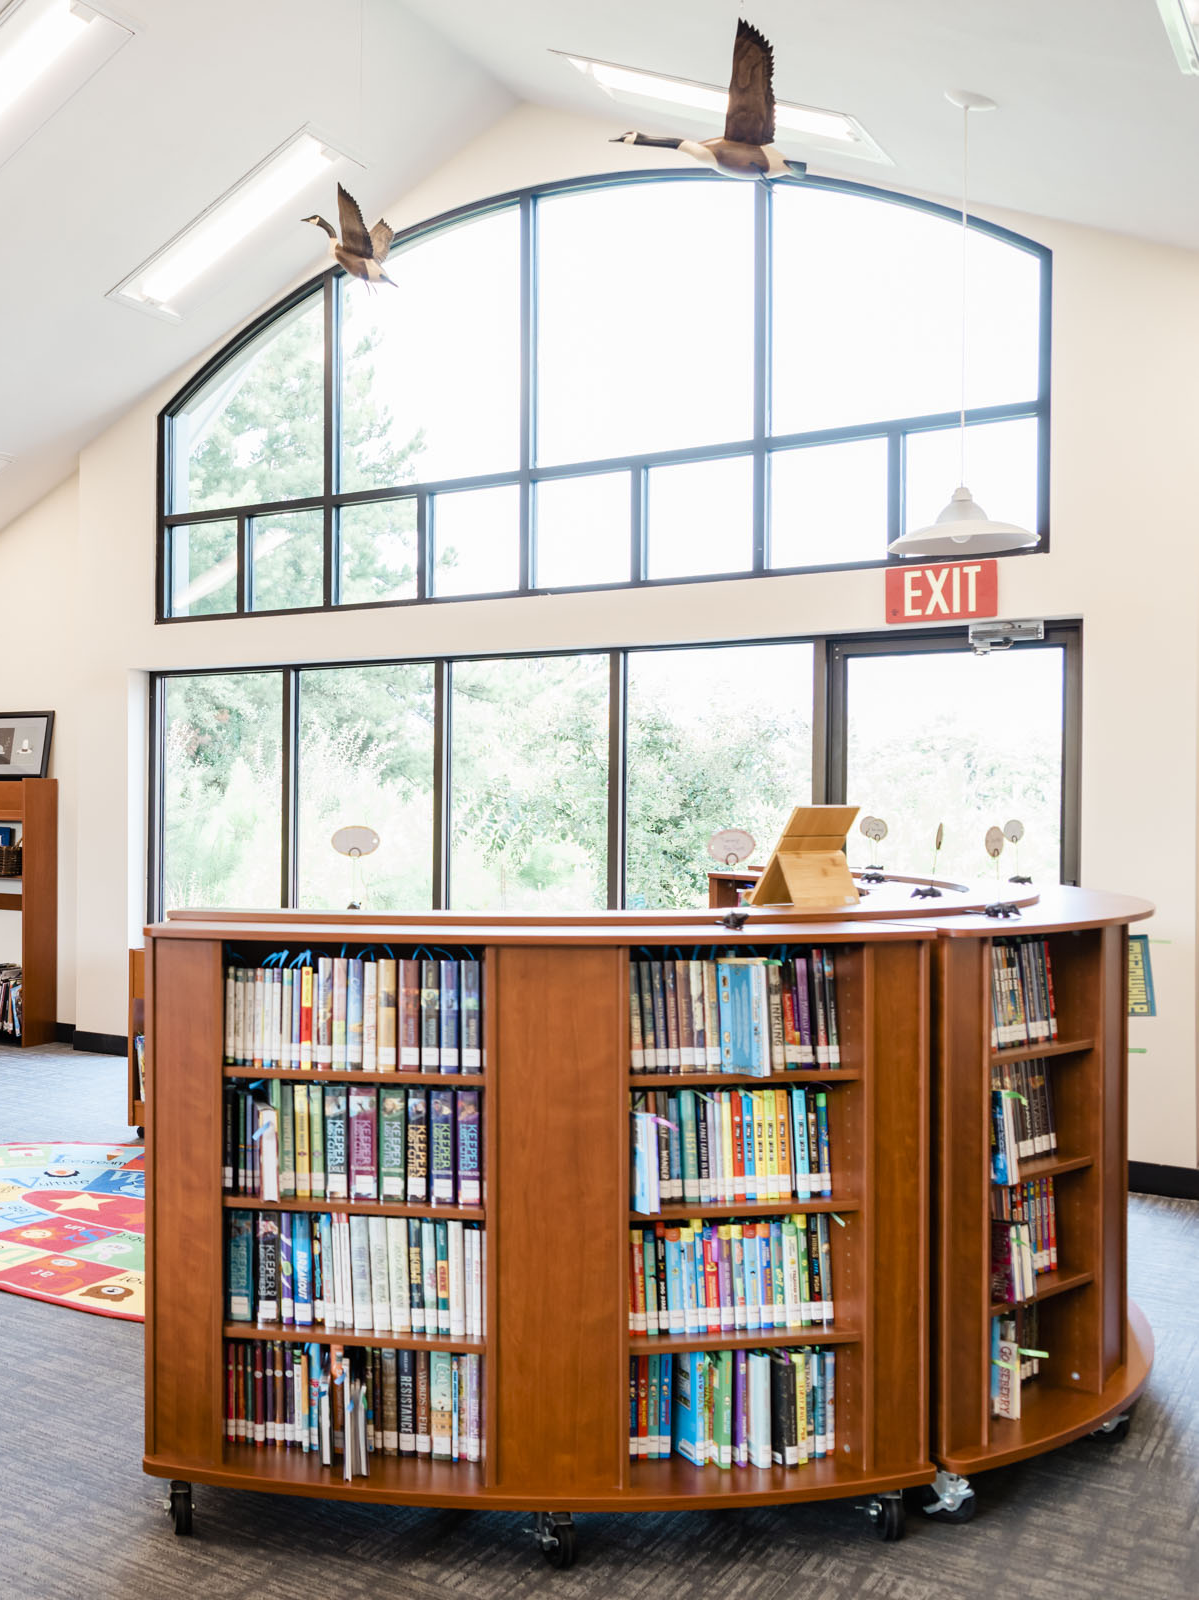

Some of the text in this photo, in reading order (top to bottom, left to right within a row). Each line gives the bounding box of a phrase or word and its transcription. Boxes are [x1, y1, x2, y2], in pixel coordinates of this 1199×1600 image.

[904, 565, 982, 617] EXIT
[772, 1002, 782, 1047] INKLING
[335, 1119, 345, 1164] KEEPER
[361, 1119, 371, 1164] KEEPER
[391, 1121, 401, 1166] KEEPER
[416, 1125, 427, 1177] KEEPER
[441, 1123, 451, 1168] KEEPER
[467, 1124, 478, 1170] KEEPER
[2, 1177, 90, 1189] Vulture
[660, 1150, 670, 1180] WANDER
[63, 1223, 116, 1243] Sun
[30, 1269, 84, 1292] Cat
[265, 1244, 275, 1289] KEEPER
[297, 1250, 308, 1300] BREAKOUT
[400, 1375, 413, 1434] RESISTANCE
[418, 1371, 427, 1406] WORDS
[418, 1416, 428, 1435] FIR
